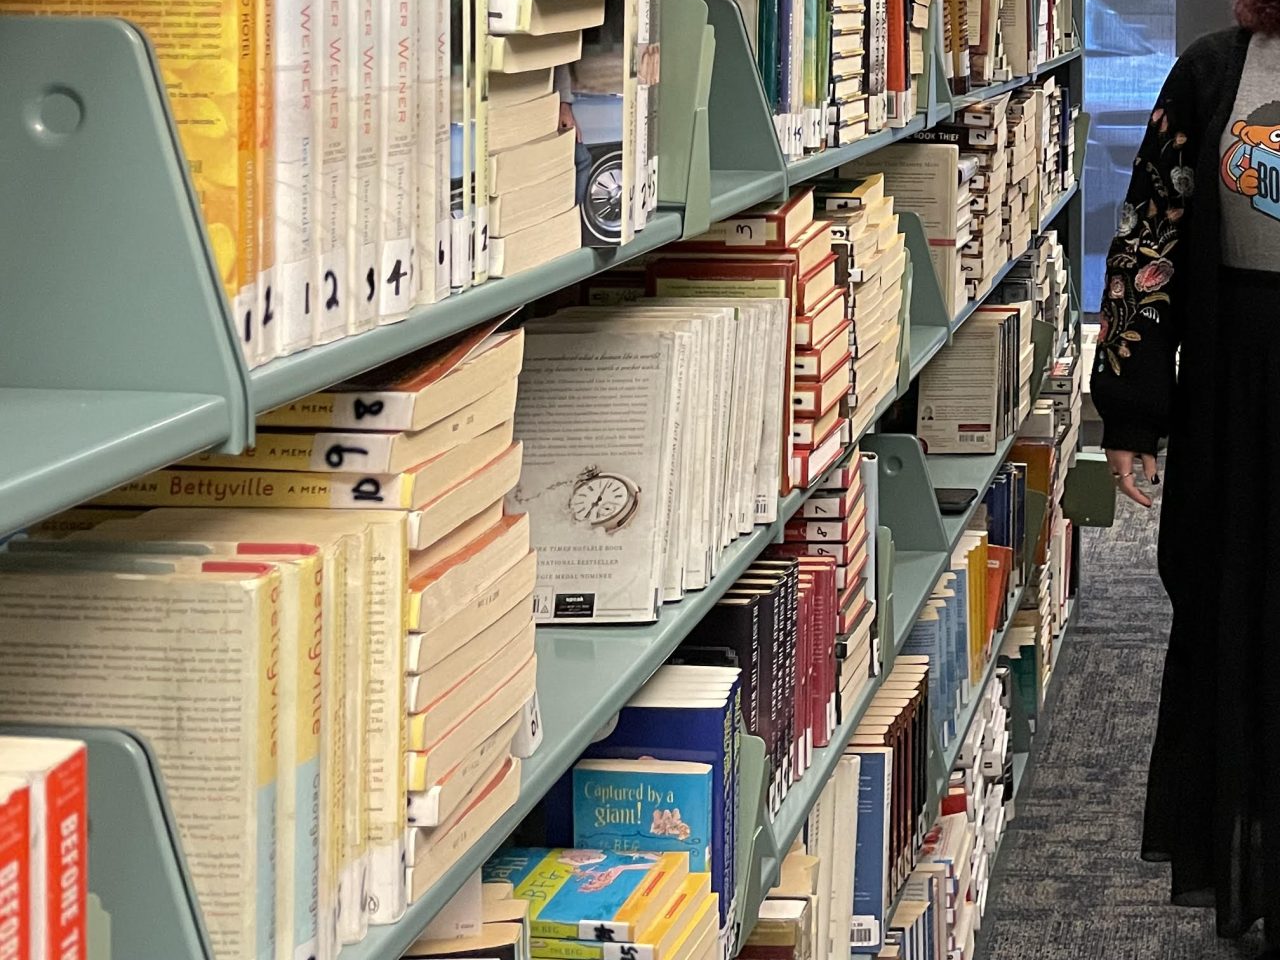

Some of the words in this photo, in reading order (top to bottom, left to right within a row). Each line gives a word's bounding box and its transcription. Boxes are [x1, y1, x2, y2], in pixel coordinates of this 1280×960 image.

[241, 12, 249, 57] HOTEL
[300, 5, 311, 110] WEINER
[330, 37, 342, 129] WEINER
[363, 46, 374, 134] WEINER
[398, 37, 410, 123] WEINER
[939, 132, 960, 142] THIEF
[737, 224, 753, 239] 3
[324, 270, 339, 310] 2
[387, 259, 408, 296] 4
[305, 282, 310, 315] 1
[354, 398, 384, 420] 8
[325, 444, 369, 468] 9
[169, 476, 275, 501] Bettyville
[299, 485, 327, 494] MEM
[352, 477, 384, 502] 10
[815, 505, 827, 514] 7
[816, 526, 828, 537] 8
[308, 569, 323, 736] Bettyville
[585, 781, 643, 805] Captured
[647, 784, 663, 805] by
[666, 791, 674, 803] a
[594, 801, 642, 827] giant!
[522, 869, 563, 901] BFG
